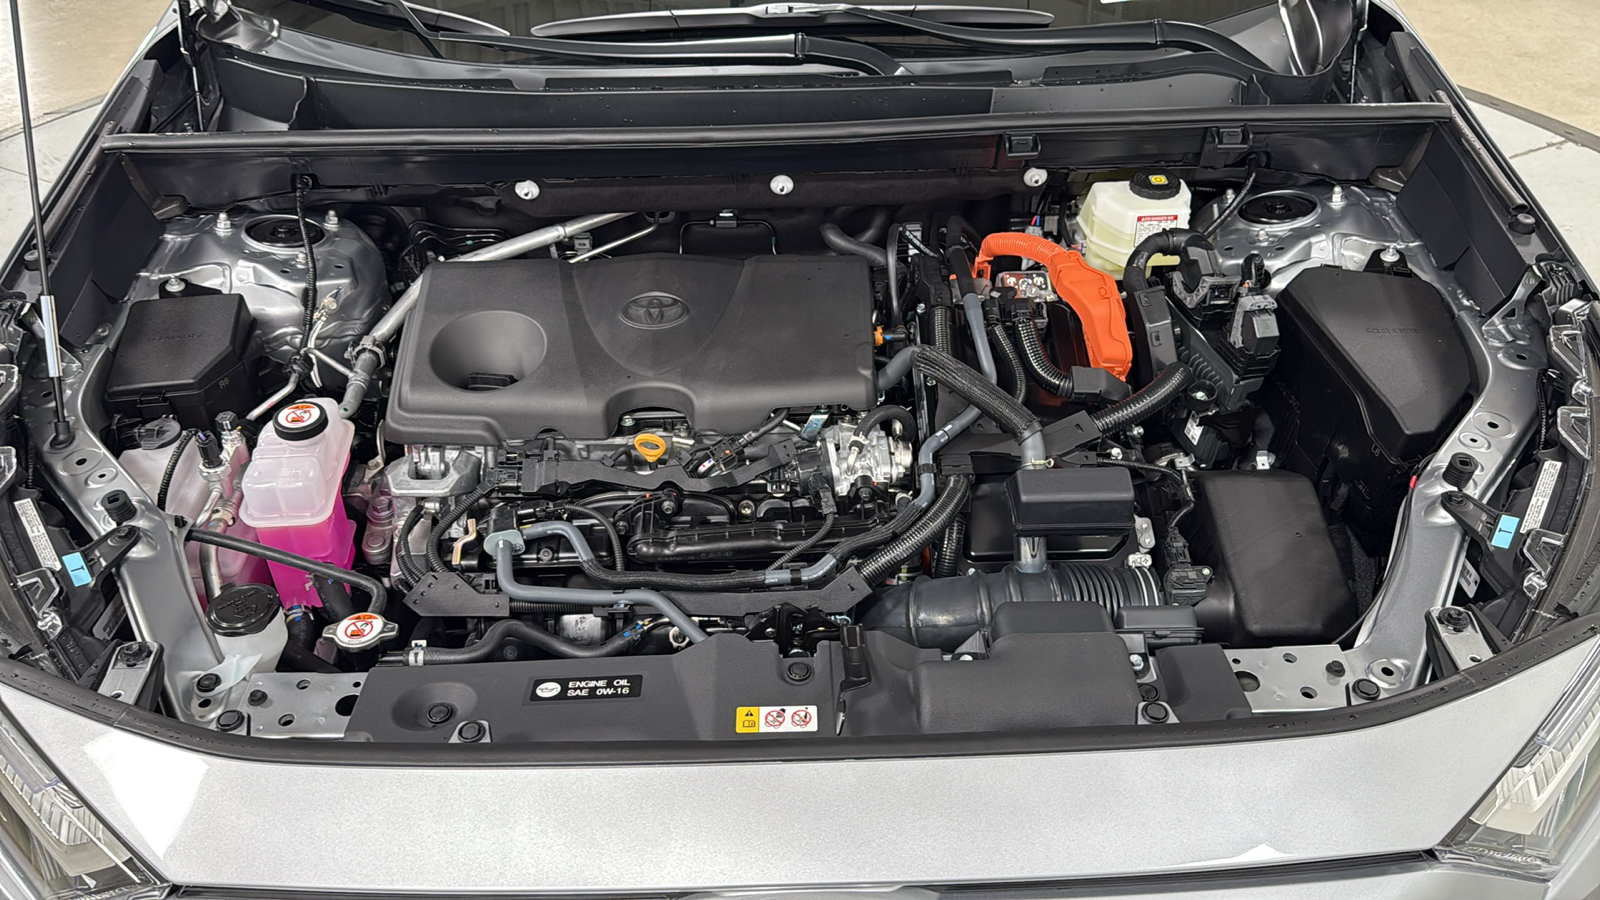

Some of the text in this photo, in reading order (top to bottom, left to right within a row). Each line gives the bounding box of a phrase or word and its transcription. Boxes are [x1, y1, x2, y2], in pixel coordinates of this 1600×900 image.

[568, 680, 608, 688] ENGINE
[566, 687, 630, 696] SAE 0W-16
